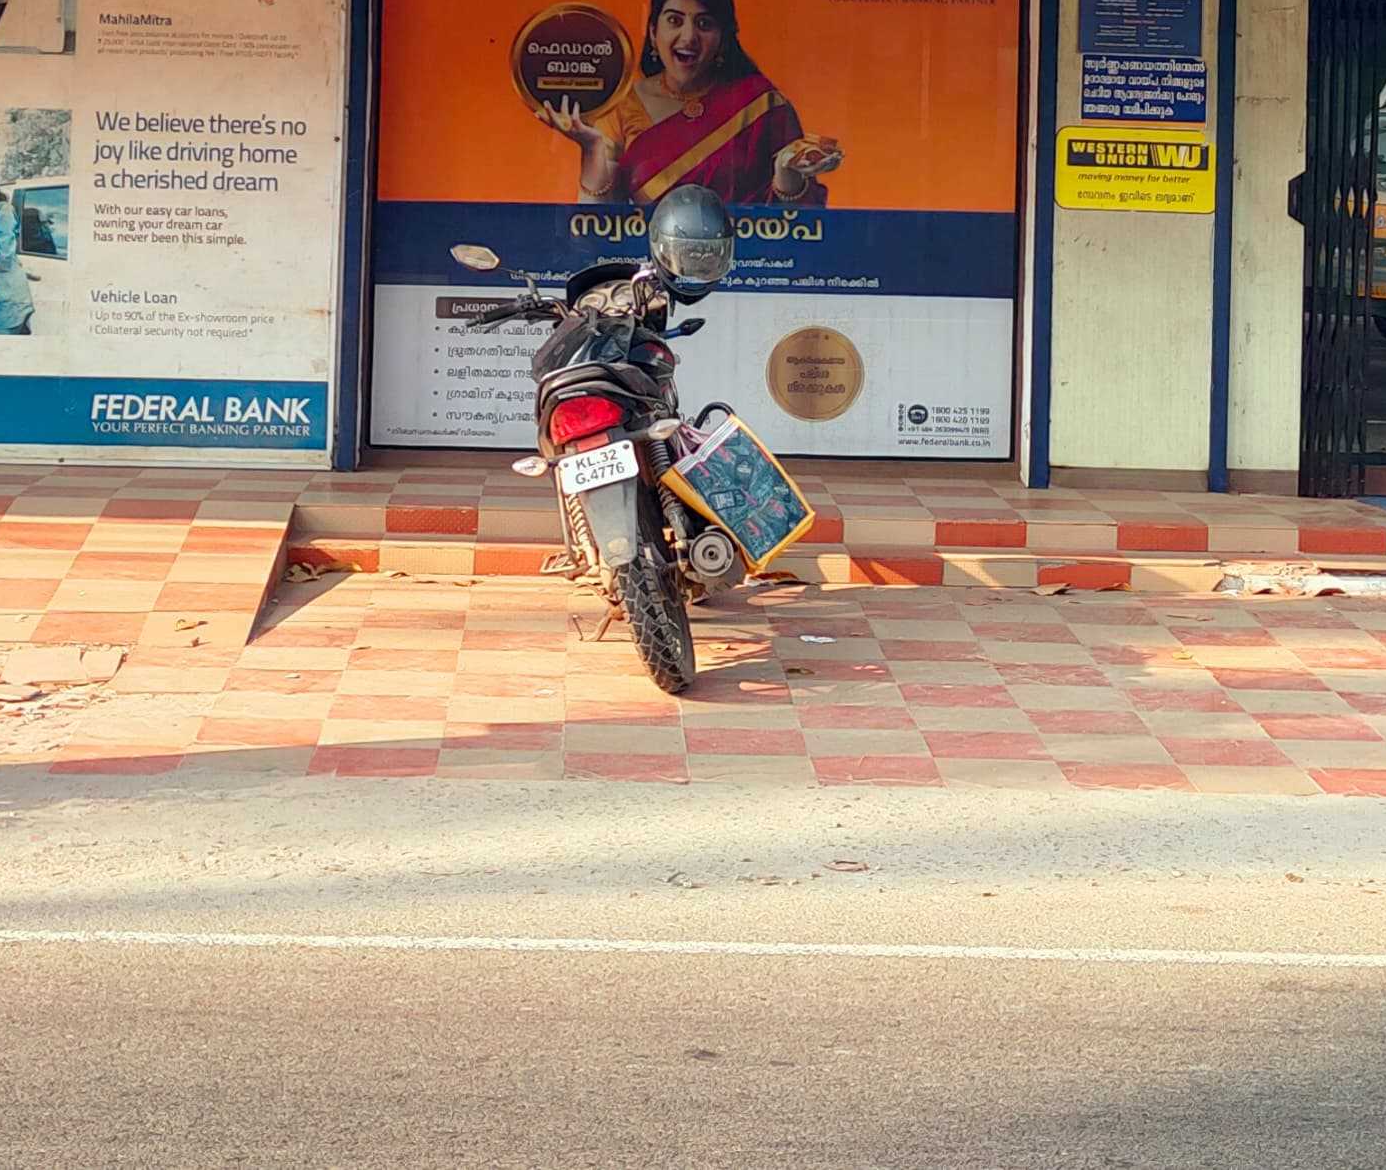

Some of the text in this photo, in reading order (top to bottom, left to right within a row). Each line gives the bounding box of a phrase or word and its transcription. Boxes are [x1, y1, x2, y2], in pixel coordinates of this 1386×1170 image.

[99, 13, 173, 27] MahilaMitra
[95, 111, 307, 136] We believe there's no
[93, 140, 298, 168] joy like driving home
[1071, 141, 1148, 155] WESTERN
[1157, 144, 1201, 168] WU
[1095, 153, 1148, 166] UNION
[93, 169, 279, 192] a cherished dream
[1078, 172, 1112, 182] moving
[1147, 174, 1160, 183] for
[1163, 174, 1190, 183] better
[93, 203, 228, 219] With our easy car loans,
[93, 218, 224, 232] owning your dream car
[93, 231, 247, 248] has never been this simple.
[90, 289, 178, 304] Vehicle Loan
[250, 313, 275, 326] price
[90, 393, 311, 424] FEDERAL BANK
[91, 420, 310, 437] YOUR PERFECT BANKING PARTNER
[575, 449, 618, 471] KL.32
[575, 461, 625, 485] G.4776
